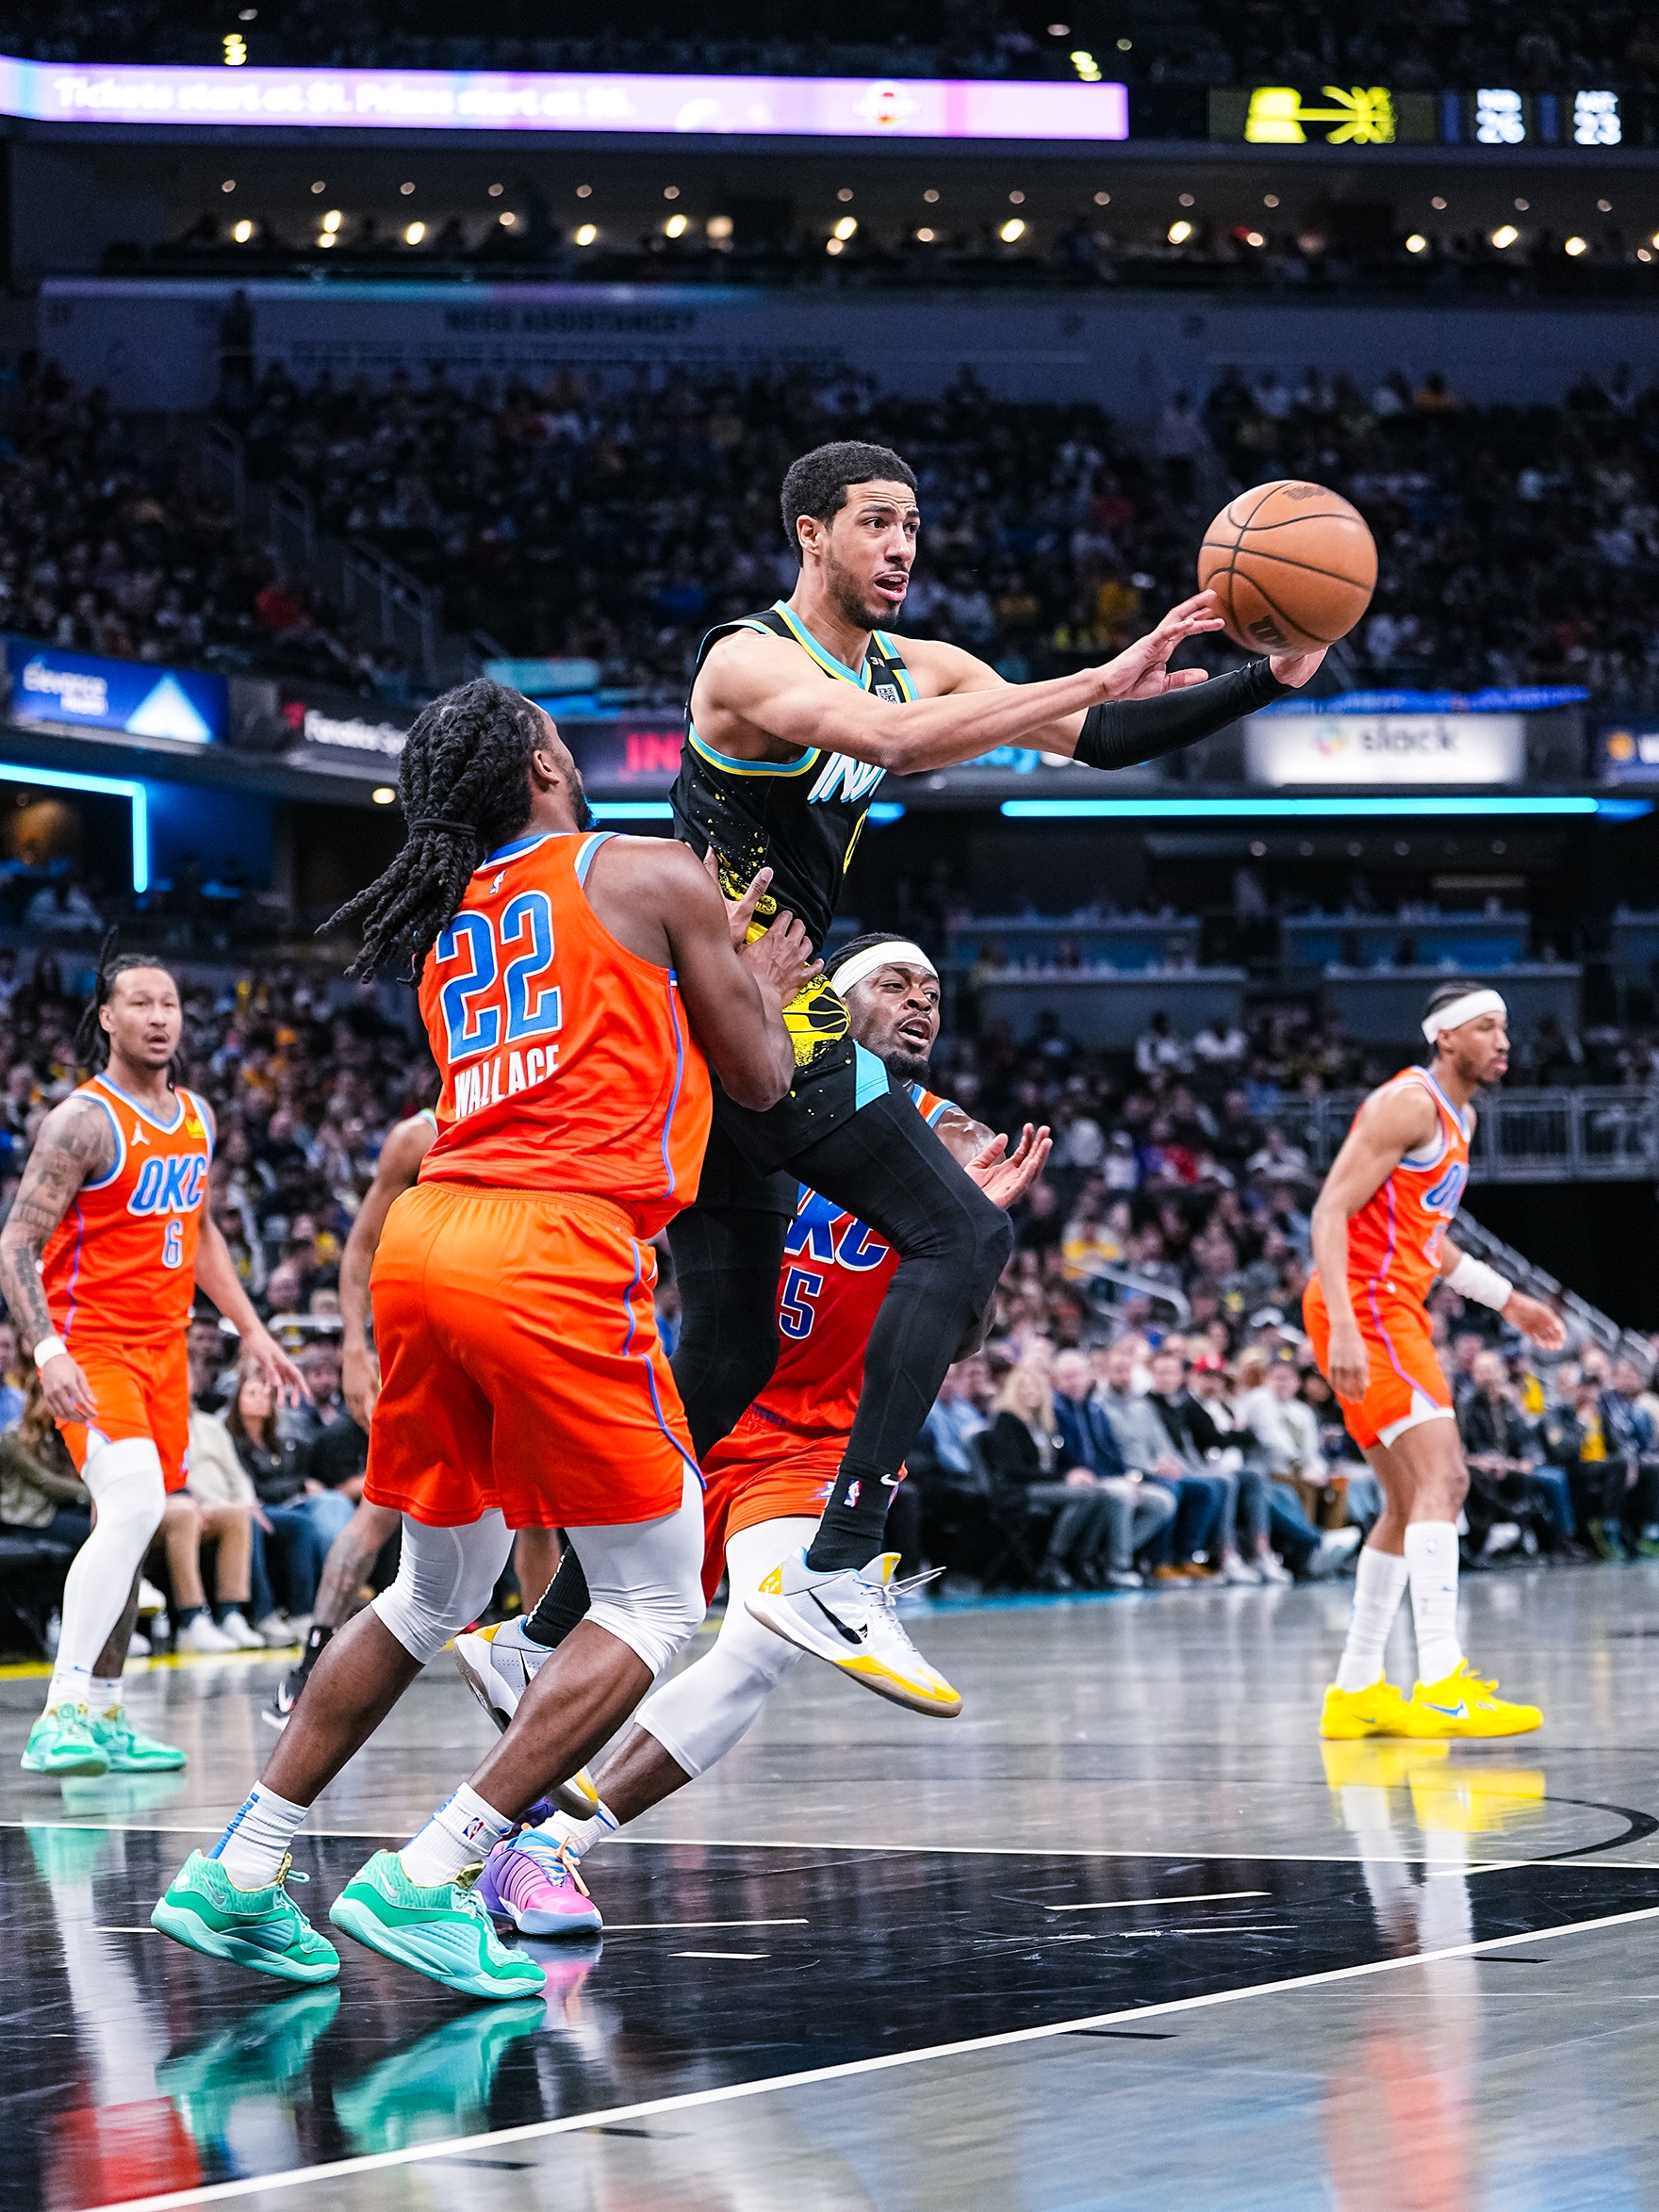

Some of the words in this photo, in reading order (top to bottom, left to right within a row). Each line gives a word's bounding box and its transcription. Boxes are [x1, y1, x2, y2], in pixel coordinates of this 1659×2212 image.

[435, 890, 562, 1065] 22
[126, 1153, 208, 1217] OKC
[161, 1218, 184, 1270] 6
[779, 1266, 825, 1340] 5
